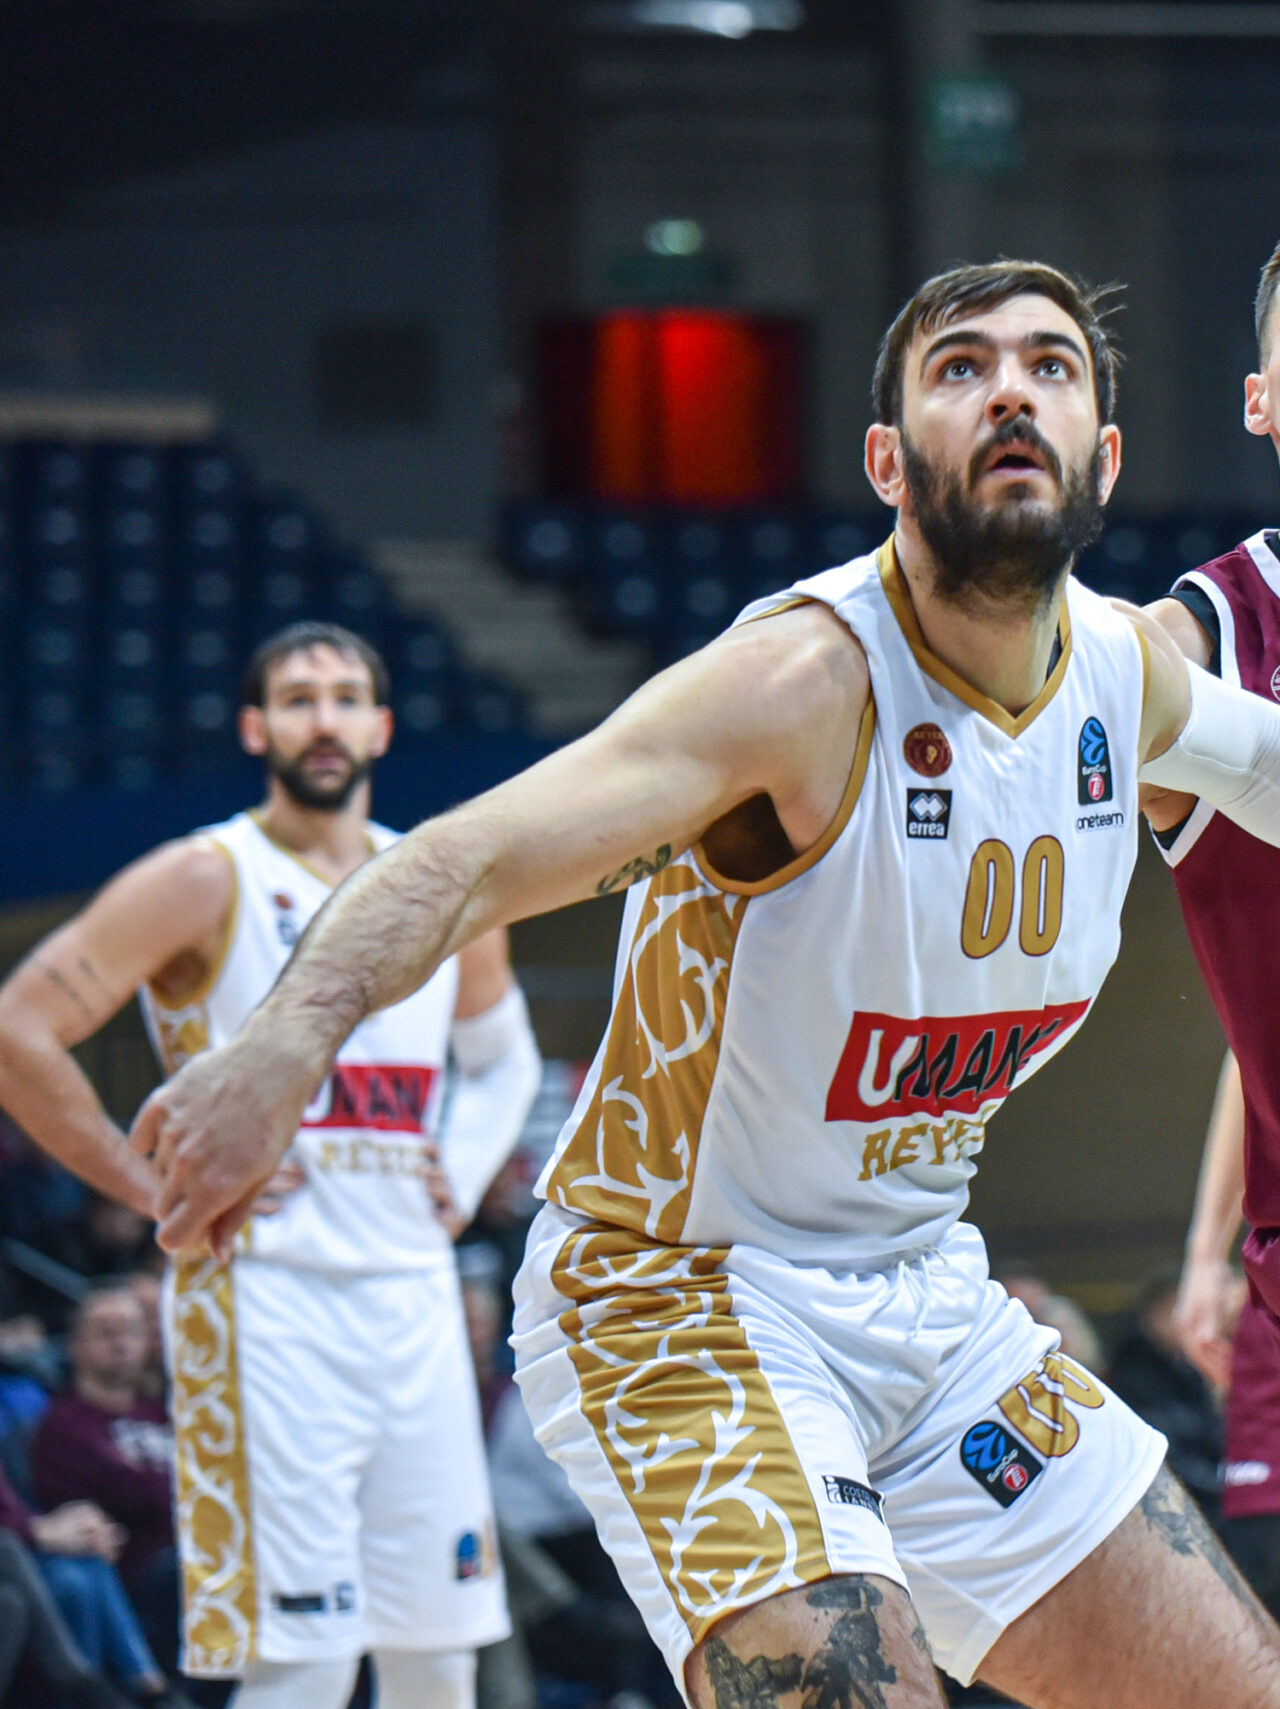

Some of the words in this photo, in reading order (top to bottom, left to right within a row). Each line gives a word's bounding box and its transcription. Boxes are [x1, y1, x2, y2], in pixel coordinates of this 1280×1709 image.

[1076, 812, 1124, 830] oneteam
[960, 834, 1065, 960] 00
[857, 1017, 1064, 1107] UMAN
